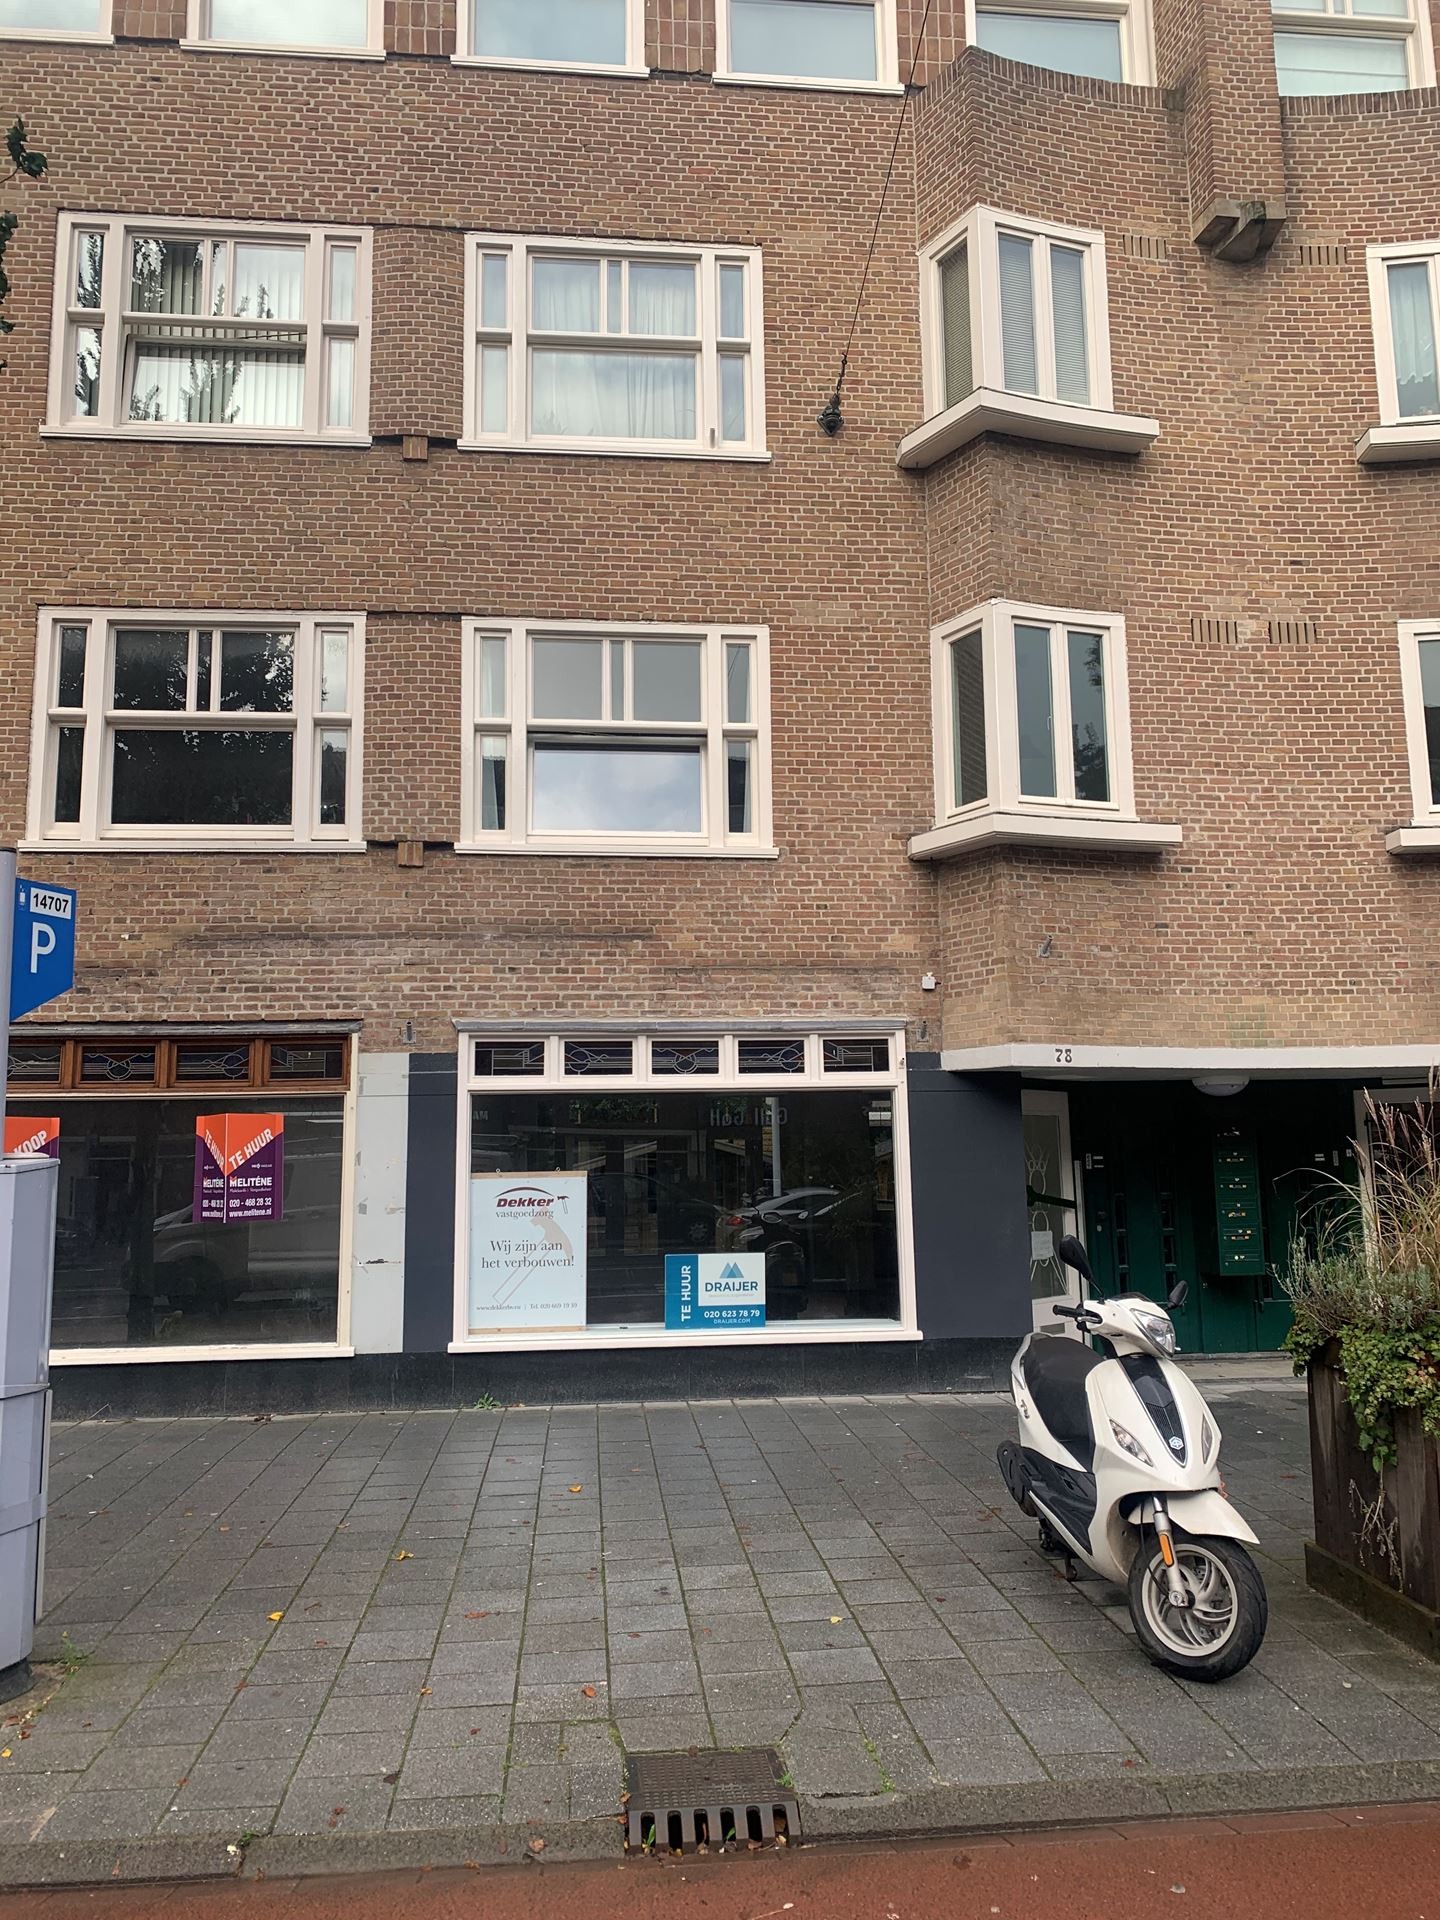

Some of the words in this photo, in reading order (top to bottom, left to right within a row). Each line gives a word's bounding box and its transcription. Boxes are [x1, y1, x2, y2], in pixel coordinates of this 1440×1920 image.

[33, 893, 69, 913] 14707
[30, 921, 56, 974] P
[1055, 1048, 1072, 1063] 78
[228, 1150, 245, 1170] TE
[243, 1128, 275, 1159] HUUR
[229, 1199, 241, 1208] 020
[264, 1197, 272, 1206] 32
[496, 1197, 554, 1208] Dekker
[496, 1208, 554, 1219] vastgoedzorg
[490, 1240, 512, 1255] Wij
[514, 1240, 537, 1255] zijn
[540, 1241, 563, 1251] aan
[481, 1257, 500, 1269] het
[504, 1256, 575, 1269] verbouwen!
[681, 1265, 691, 1301] HUUR
[705, 1281, 758, 1292] DRAIJER
[681, 1304, 691, 1322] TE
[704, 1310, 720, 1318] 020
[722, 1310, 736, 1318] 623
[739, 1309, 748, 1317] 78
[750, 1309, 760, 1317] 79
